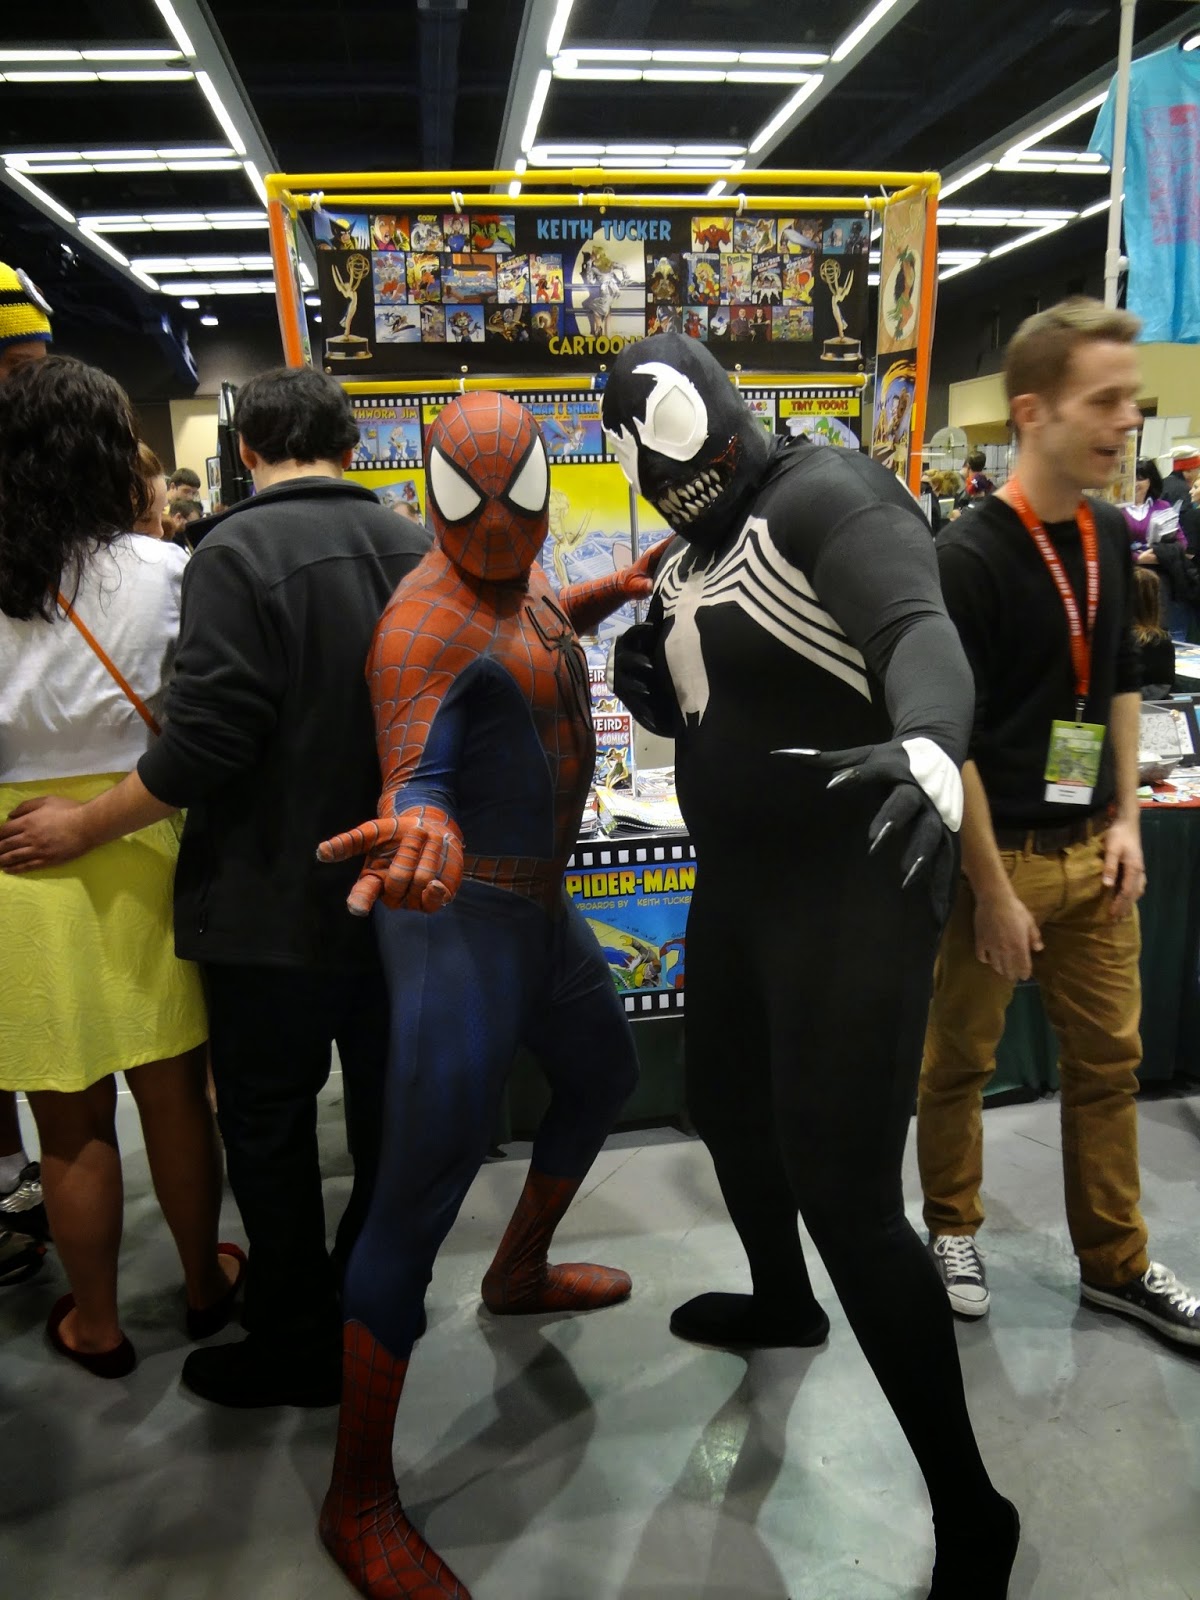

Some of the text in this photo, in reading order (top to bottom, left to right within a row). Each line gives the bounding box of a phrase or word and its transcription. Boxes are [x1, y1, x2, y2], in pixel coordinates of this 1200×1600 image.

[536, 219, 672, 241] KEITH TUCKER
[791, 400, 849, 411] TINY TOONS
[401, 407, 418, 418] JIM
[617, 899, 629, 908] BY
[637, 898, 660, 906] KEITH
